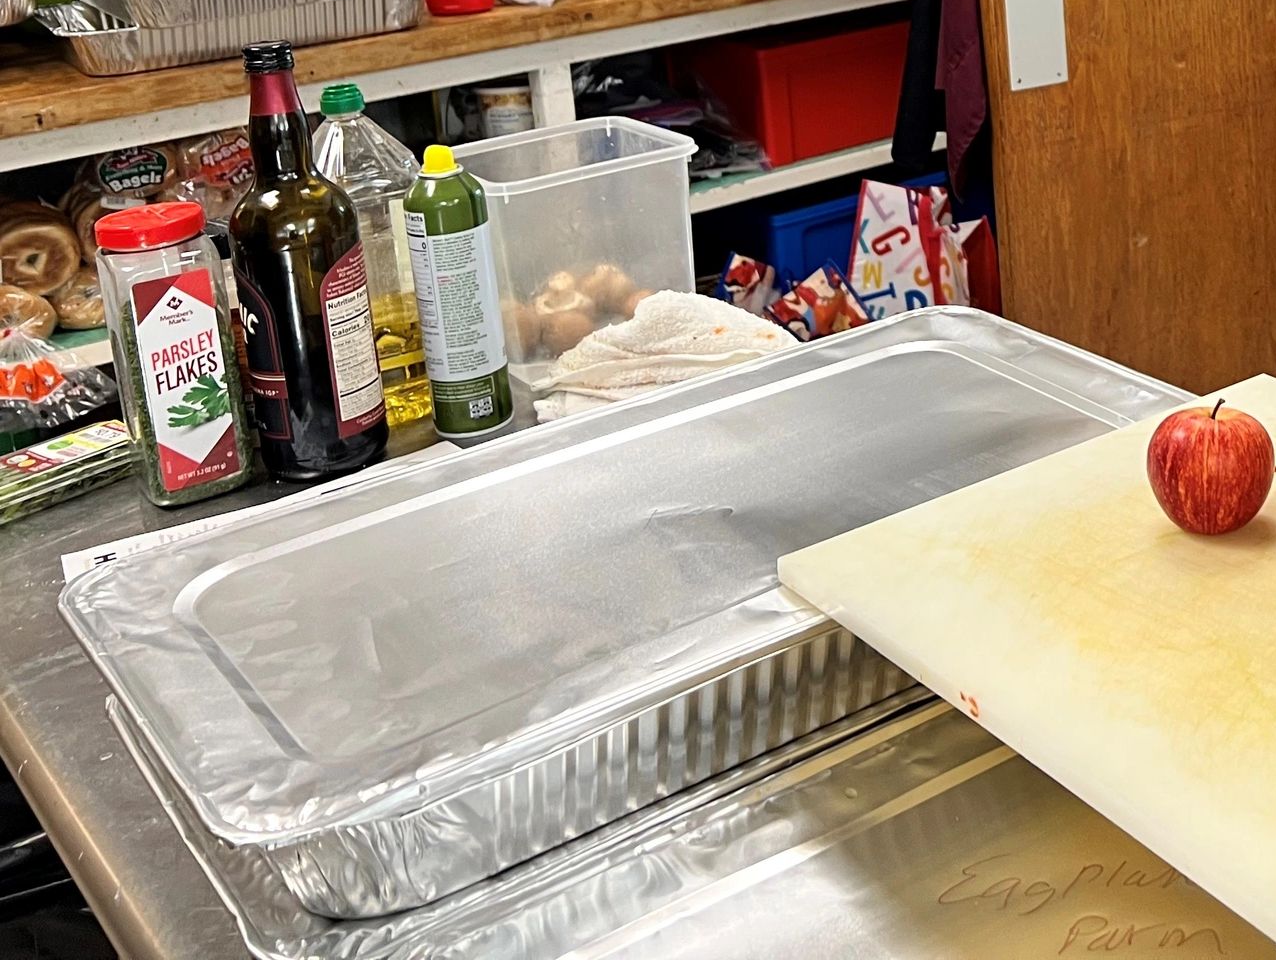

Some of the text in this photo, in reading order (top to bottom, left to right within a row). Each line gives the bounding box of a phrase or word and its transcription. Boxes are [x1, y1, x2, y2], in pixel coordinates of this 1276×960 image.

[108, 171, 162, 192] Bagels
[328, 296, 356, 310] Nutrition
[159, 309, 194, 322] Member's
[331, 323, 360, 337] Calories
[151, 328, 214, 372] PARSLEY
[155, 350, 218, 395] FLAKES
[177, 471, 188, 480] NET
[1058, 915, 1224, 955] Parm
